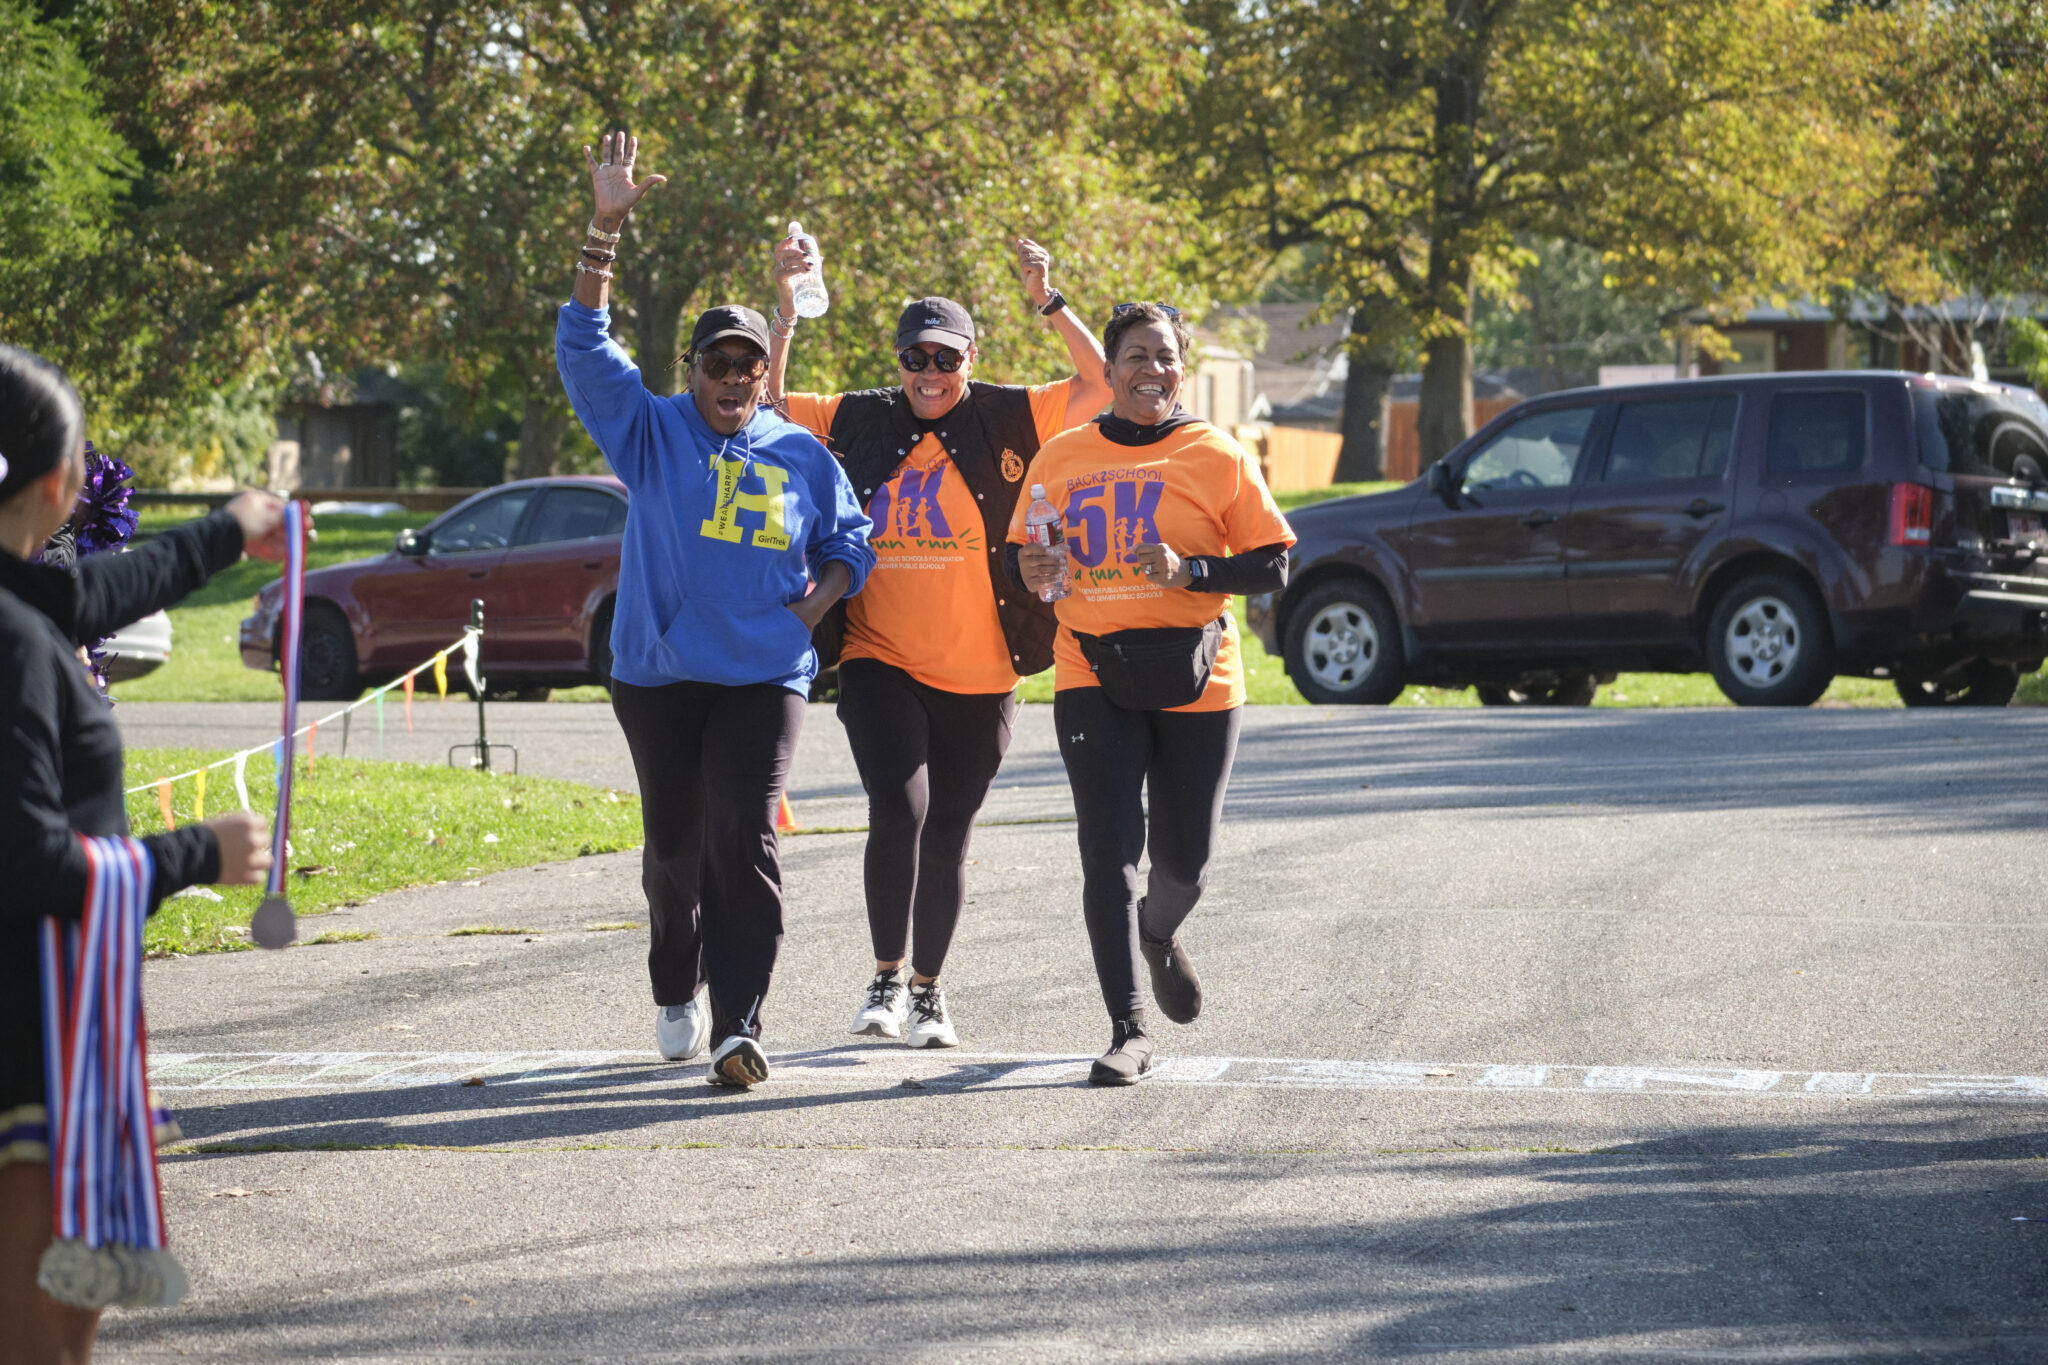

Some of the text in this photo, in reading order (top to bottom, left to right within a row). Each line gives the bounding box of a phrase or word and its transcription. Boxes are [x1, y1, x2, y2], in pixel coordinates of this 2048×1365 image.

[1066, 468, 1162, 492] BACK2SCHOOL
[1065, 481, 1165, 568] 5K
[758, 535, 786, 546] GirlTrek
[867, 537, 958, 549] un run
[1075, 568, 1082, 580] a
[1089, 562, 1123, 587] fun
